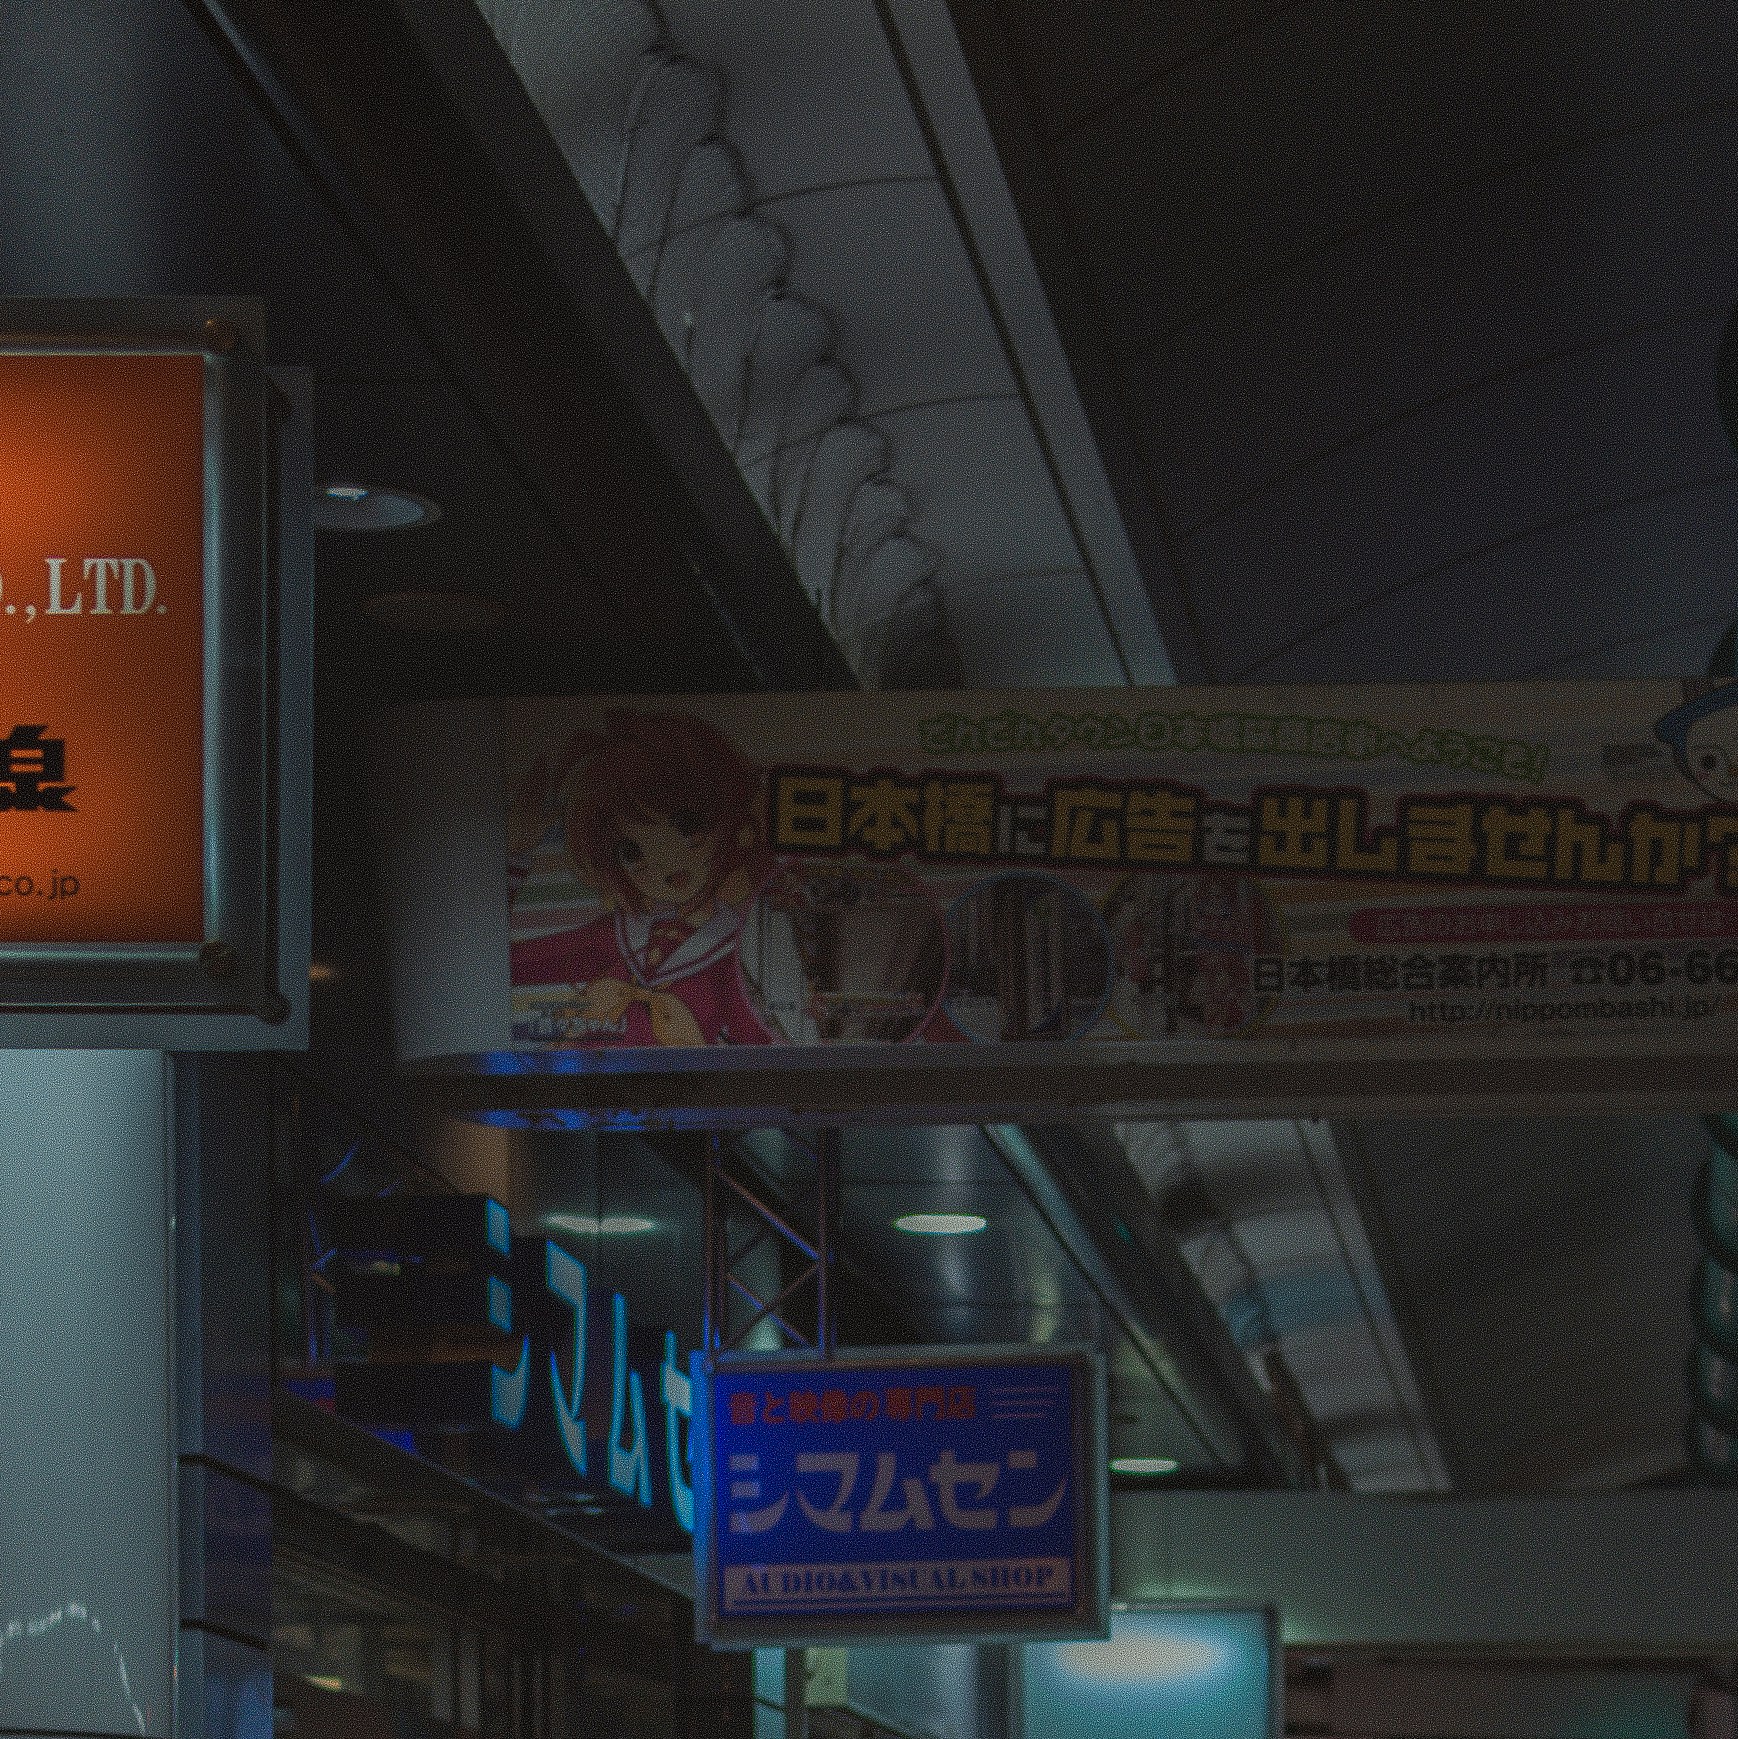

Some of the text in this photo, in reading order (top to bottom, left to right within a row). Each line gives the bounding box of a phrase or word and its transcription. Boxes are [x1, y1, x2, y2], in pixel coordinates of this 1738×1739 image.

[0, 557, 168, 623] .,LTD.
[1252, 950, 1549, 994] 日本橋総合案内所
[729, 1385, 977, 1427] 音と映像の専門店
[729, 1448, 1068, 1535] シマムセン
[971, 1566, 1054, 1590] SHOP
